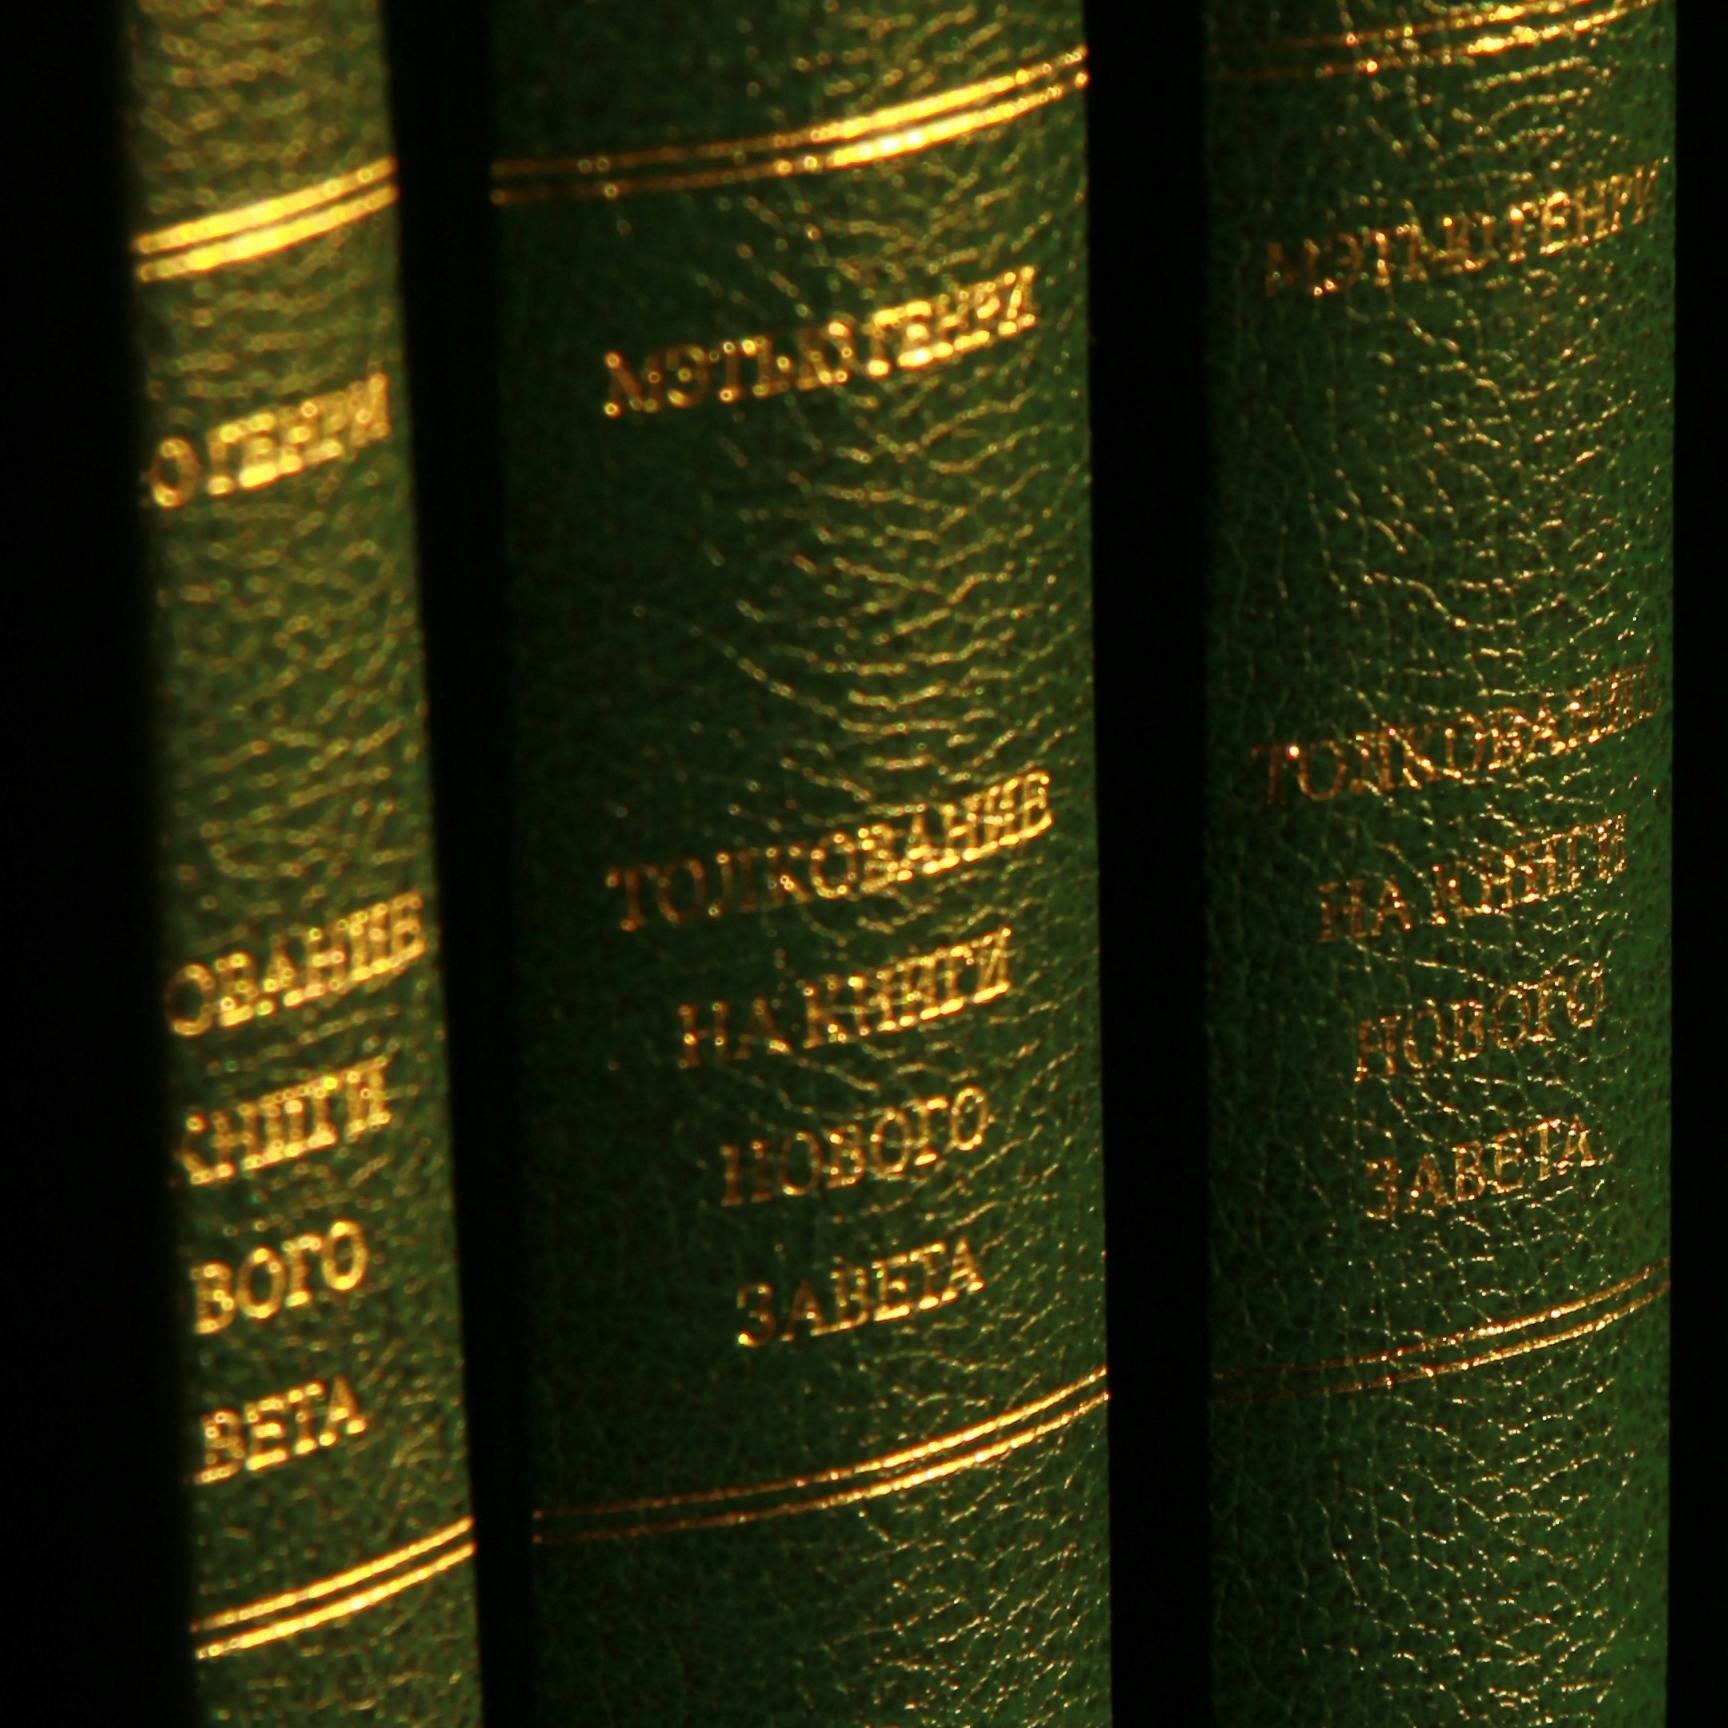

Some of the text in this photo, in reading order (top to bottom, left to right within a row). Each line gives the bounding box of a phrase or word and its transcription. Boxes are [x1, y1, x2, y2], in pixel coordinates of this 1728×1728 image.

[603, 265, 1038, 419] МЭТЬЮ ГЕНРИ
[604, 767, 1053, 934] ТОЛКОВАНИЕ
[676, 925, 1013, 1069] НА КНИГИ
[718, 1084, 992, 1208] НОВОГО
[189, 1217, 369, 1335] ВОГО
[735, 1235, 987, 1351] ЗАВЕТА
[195, 1375, 367, 1485] ВЕТА
